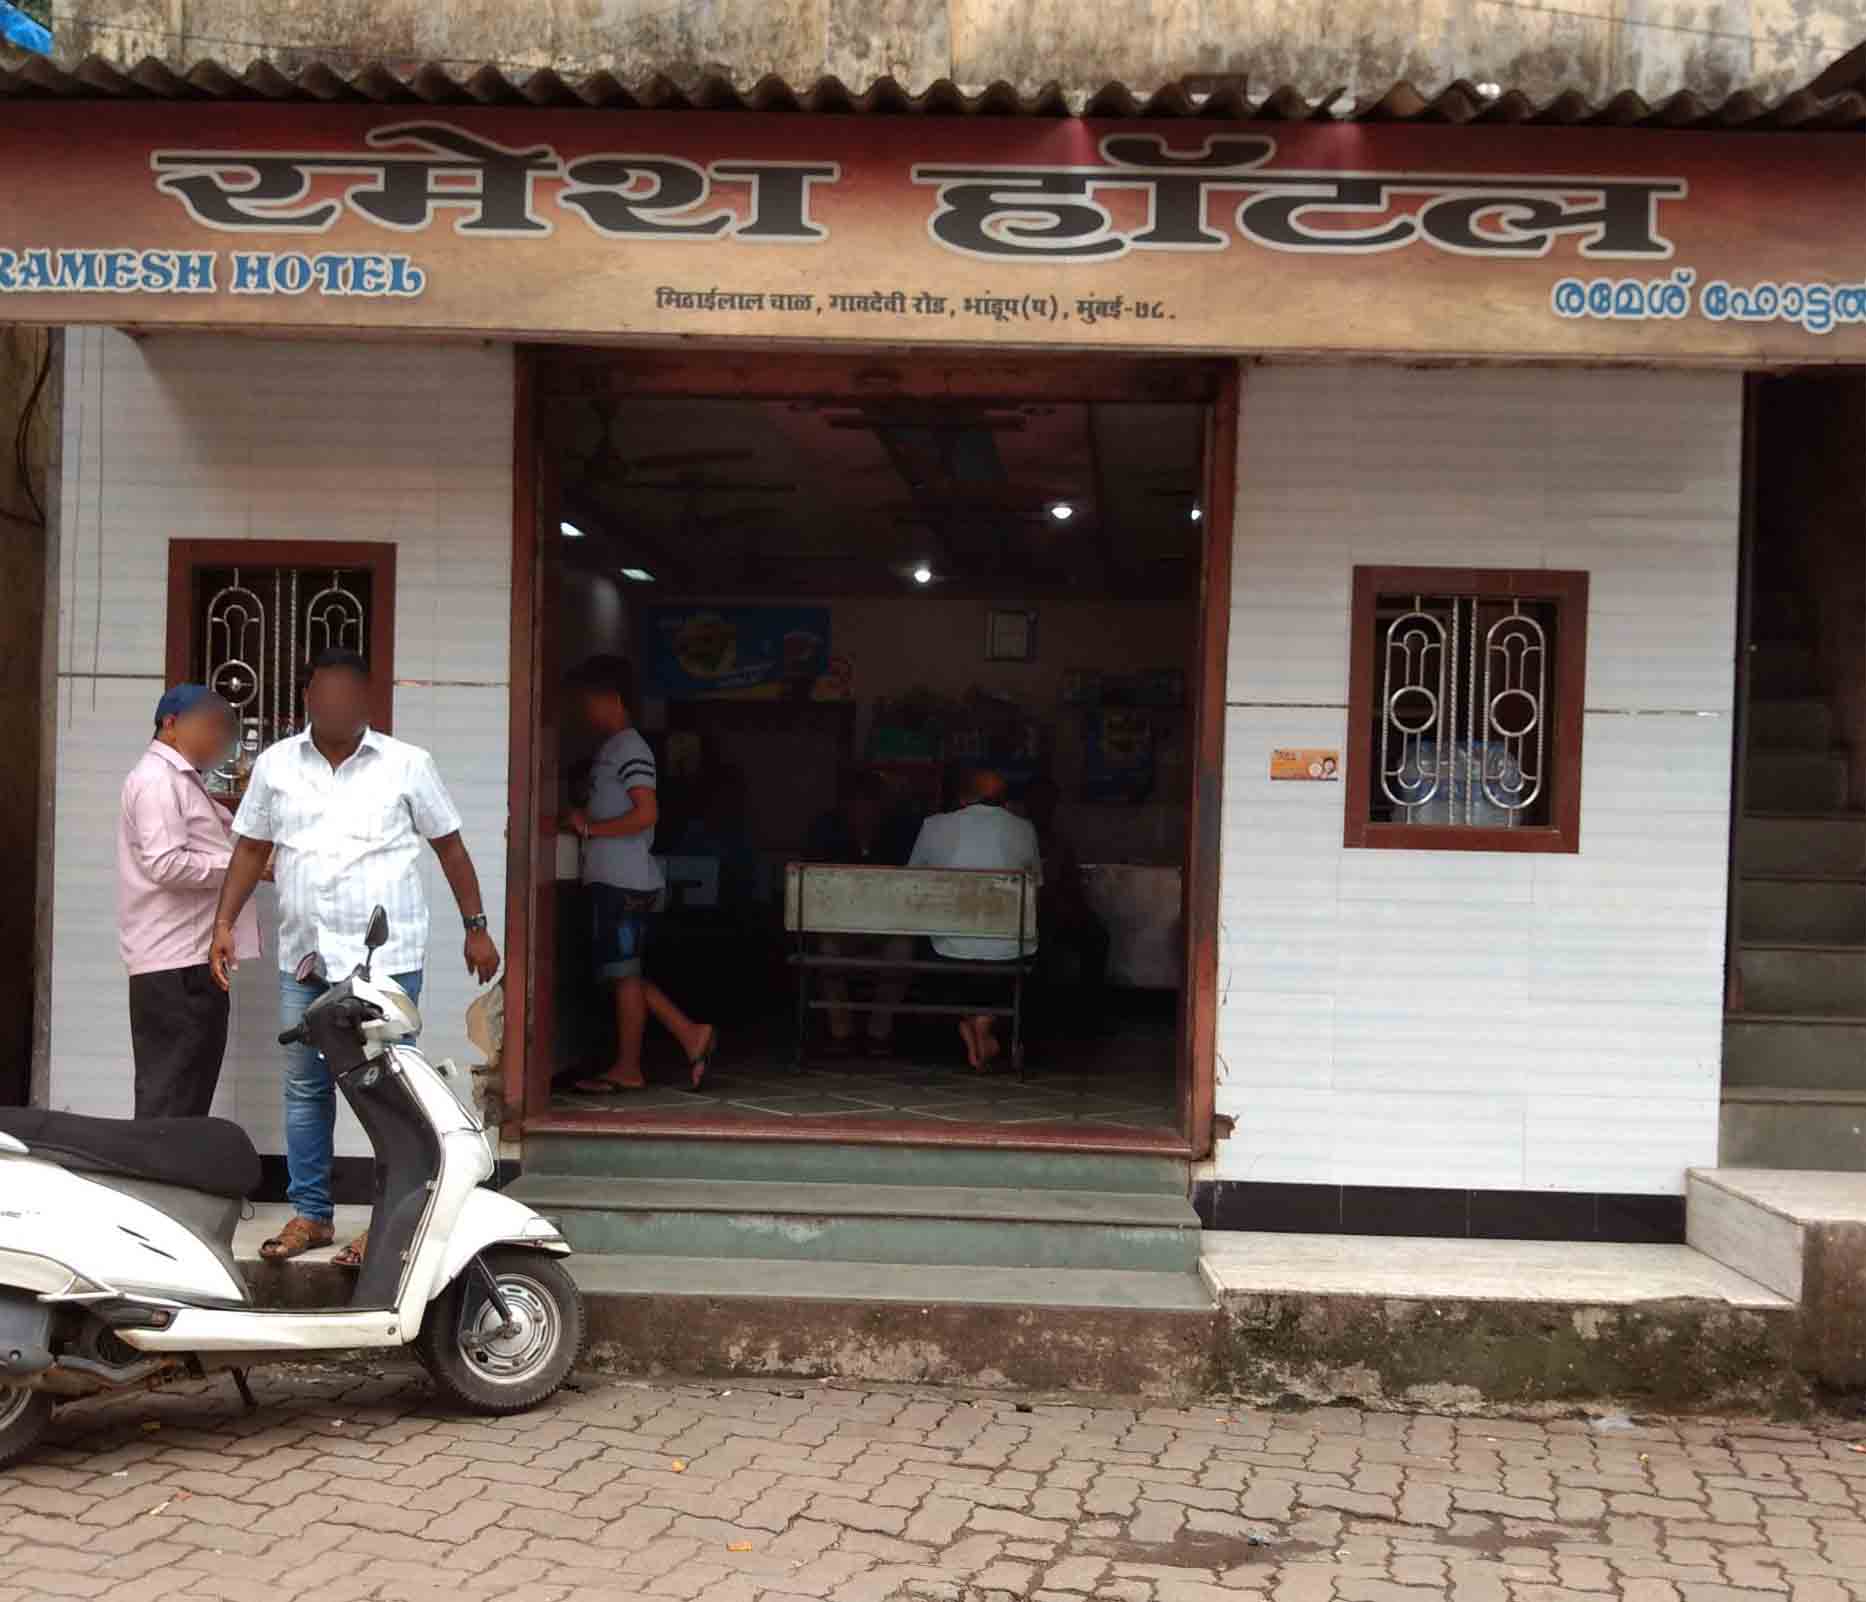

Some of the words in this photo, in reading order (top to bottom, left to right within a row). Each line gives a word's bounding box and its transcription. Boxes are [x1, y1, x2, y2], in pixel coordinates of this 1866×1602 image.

[151, 121, 841, 243] रमेश
[0, 248, 217, 296] RAMESH
[229, 251, 426, 298] HOTEL
